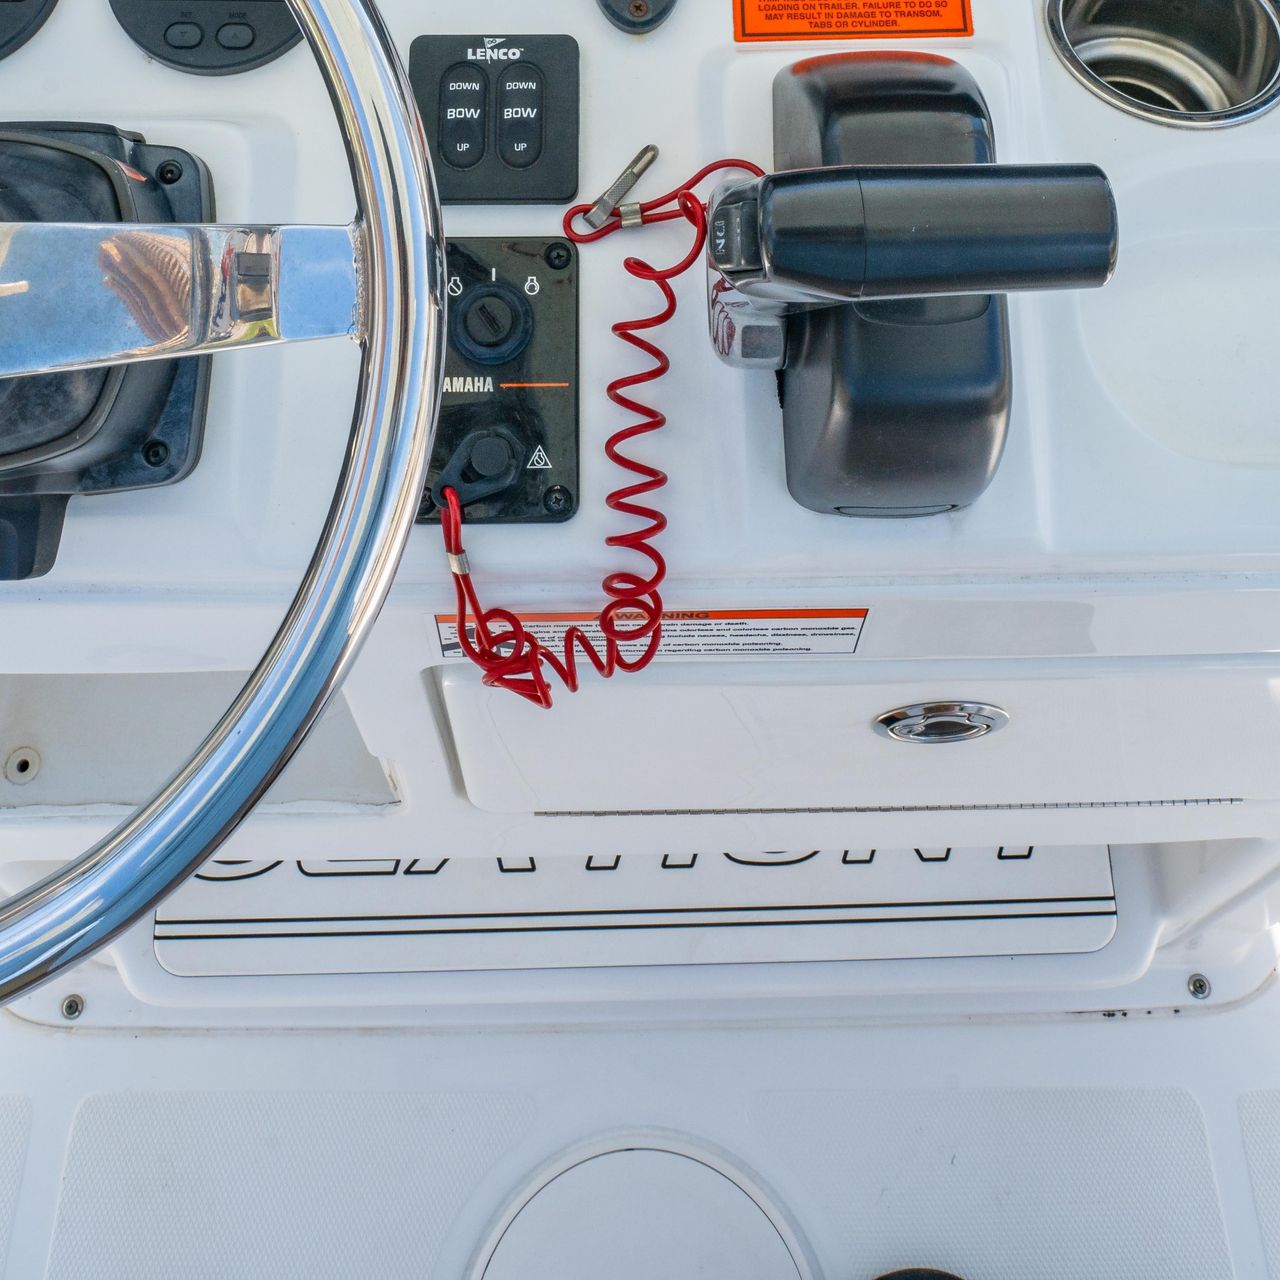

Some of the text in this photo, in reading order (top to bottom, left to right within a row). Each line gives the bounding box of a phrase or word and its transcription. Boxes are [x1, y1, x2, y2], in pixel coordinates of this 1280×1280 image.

[758, 3, 800, 11] LOADING
[803, 3, 816, 11] ON
[819, 2, 860, 10] TRAILER.
[862, 1, 902, 10] FAILURE
[903, 1, 917, 9] TO
[935, 0, 948, 8] SO
[765, 10, 942, 20] MAY RESULT IN DAMAGE TO TRANSOM,
[808, 21, 833, 29] TABS
[851, 20, 900, 28] CYLINDER.
[467, 48, 522, 60] LENCO
[449, 82, 480, 91] DOWN
[506, 82, 537, 90] DOWN
[447, 108, 480, 119] BOW
[504, 108, 537, 119] BOW
[456, 143, 470, 151] UP
[514, 143, 527, 151] UP
[442, 376, 494, 393] AMAHA
[616, 611, 709, 620] WANING
